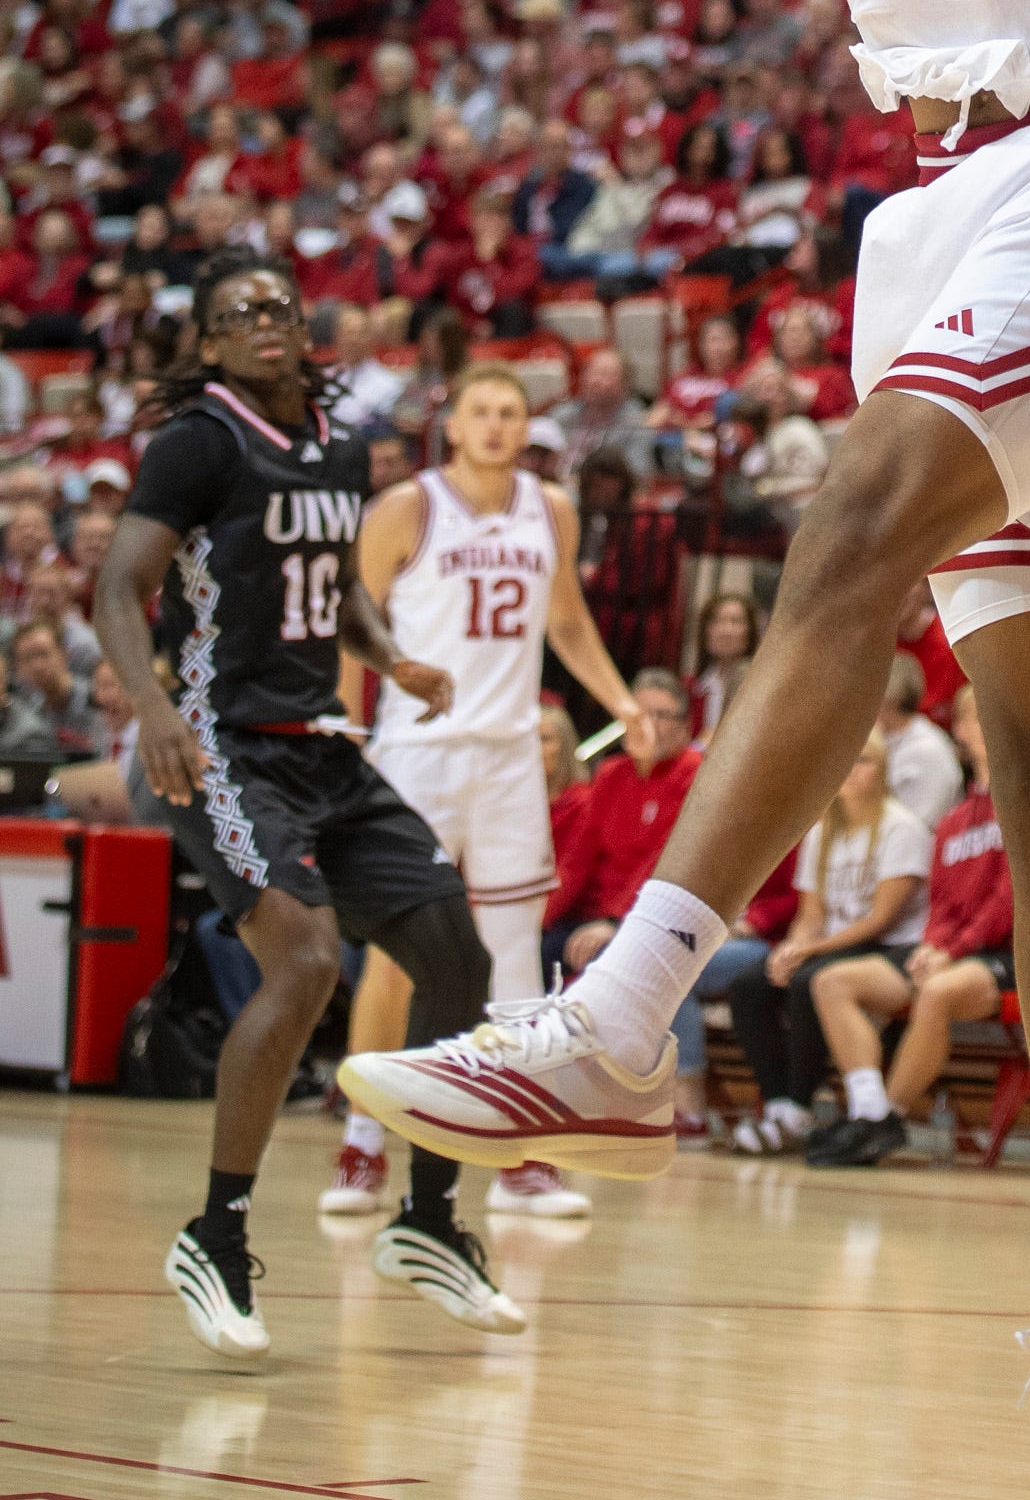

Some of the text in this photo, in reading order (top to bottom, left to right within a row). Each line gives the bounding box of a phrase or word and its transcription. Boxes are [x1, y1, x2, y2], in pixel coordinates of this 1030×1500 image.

[263, 490, 361, 544] UIW
[281, 552, 341, 641] 10
[466, 577, 526, 639] 12
